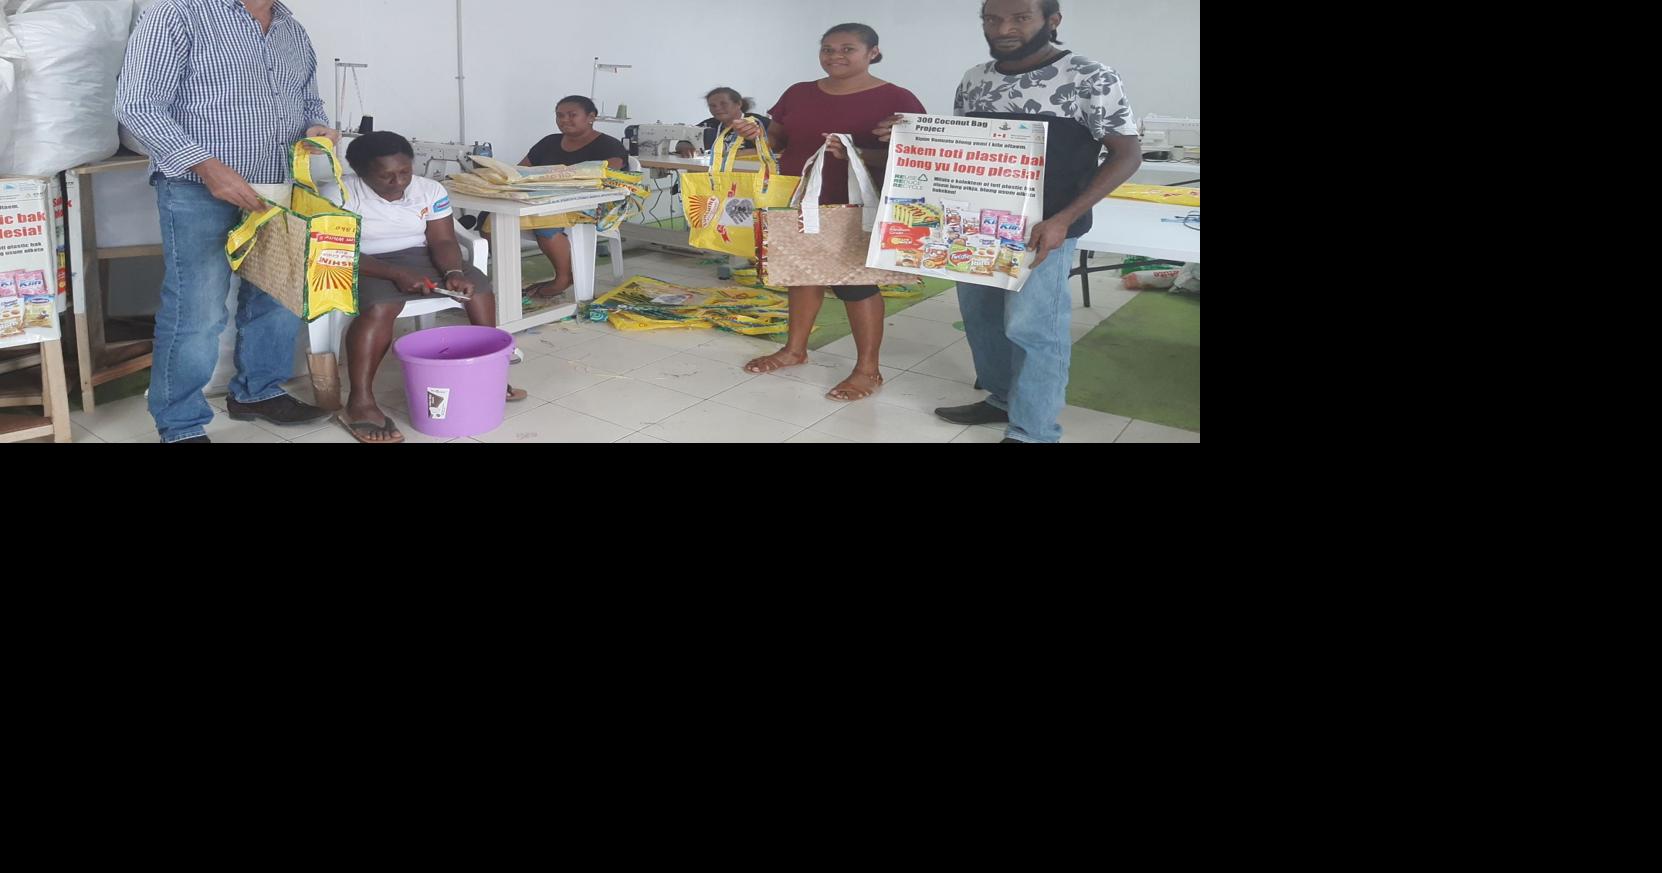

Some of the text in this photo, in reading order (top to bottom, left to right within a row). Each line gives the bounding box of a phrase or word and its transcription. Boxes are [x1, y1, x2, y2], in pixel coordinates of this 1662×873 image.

[915, 125, 945, 133] Project
[934, 118, 970, 126] Coconut
[971, 120, 988, 128] Bag
[895, 144, 936, 157] Sakem
[940, 148, 964, 159] toti
[966, 150, 1018, 164] plastic
[896, 156, 1041, 181] blong yu long plesia!
[17, 211, 46, 224] bak
